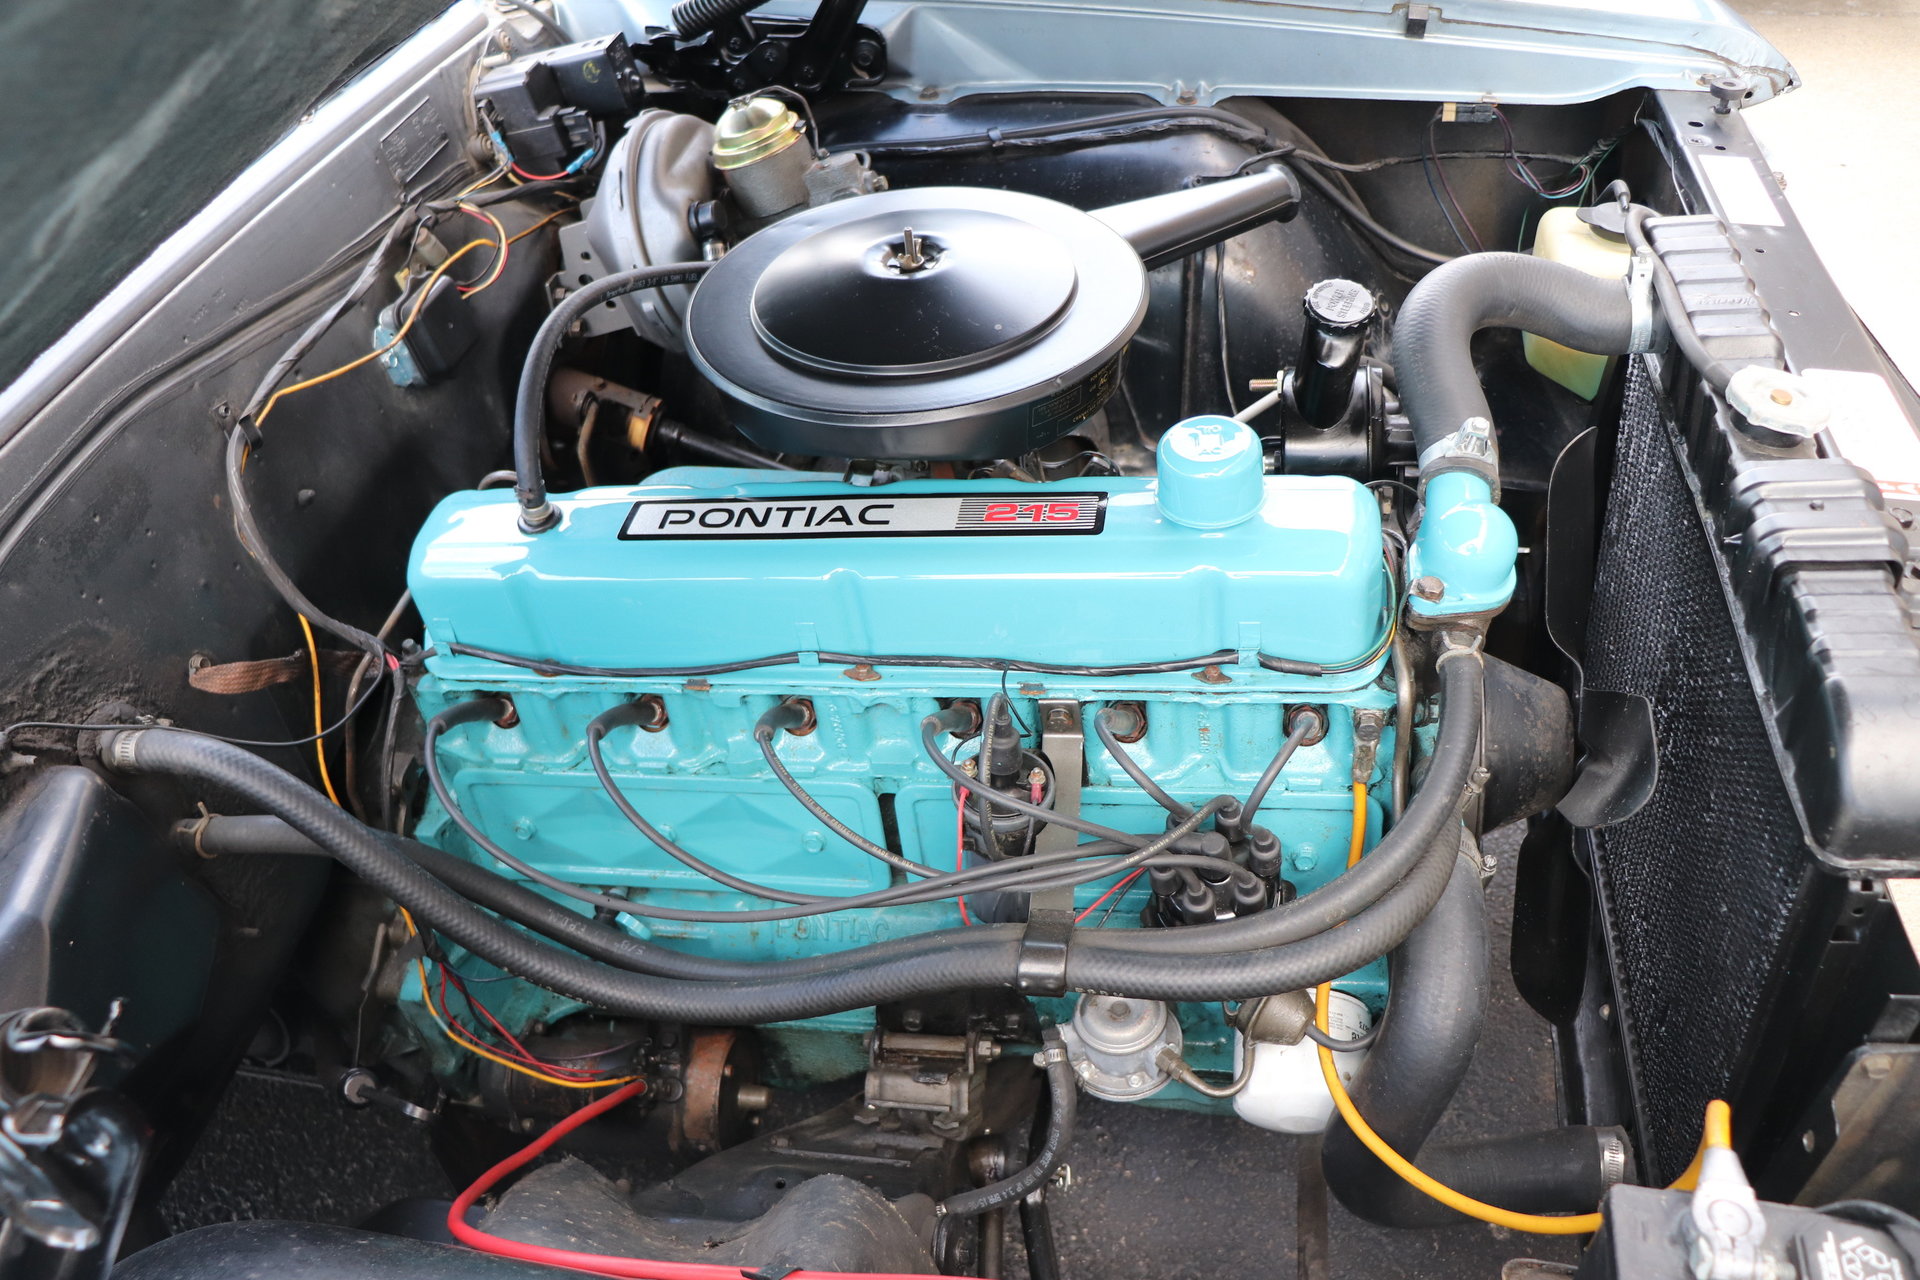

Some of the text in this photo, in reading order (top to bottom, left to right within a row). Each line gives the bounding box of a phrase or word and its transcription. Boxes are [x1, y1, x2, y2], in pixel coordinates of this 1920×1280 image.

[658, 502, 1080, 530] PONTIAC 215
[872, 845, 889, 858] MADE
[902, 859, 914, 868] USA
[776, 914, 890, 944] PONTIAC
